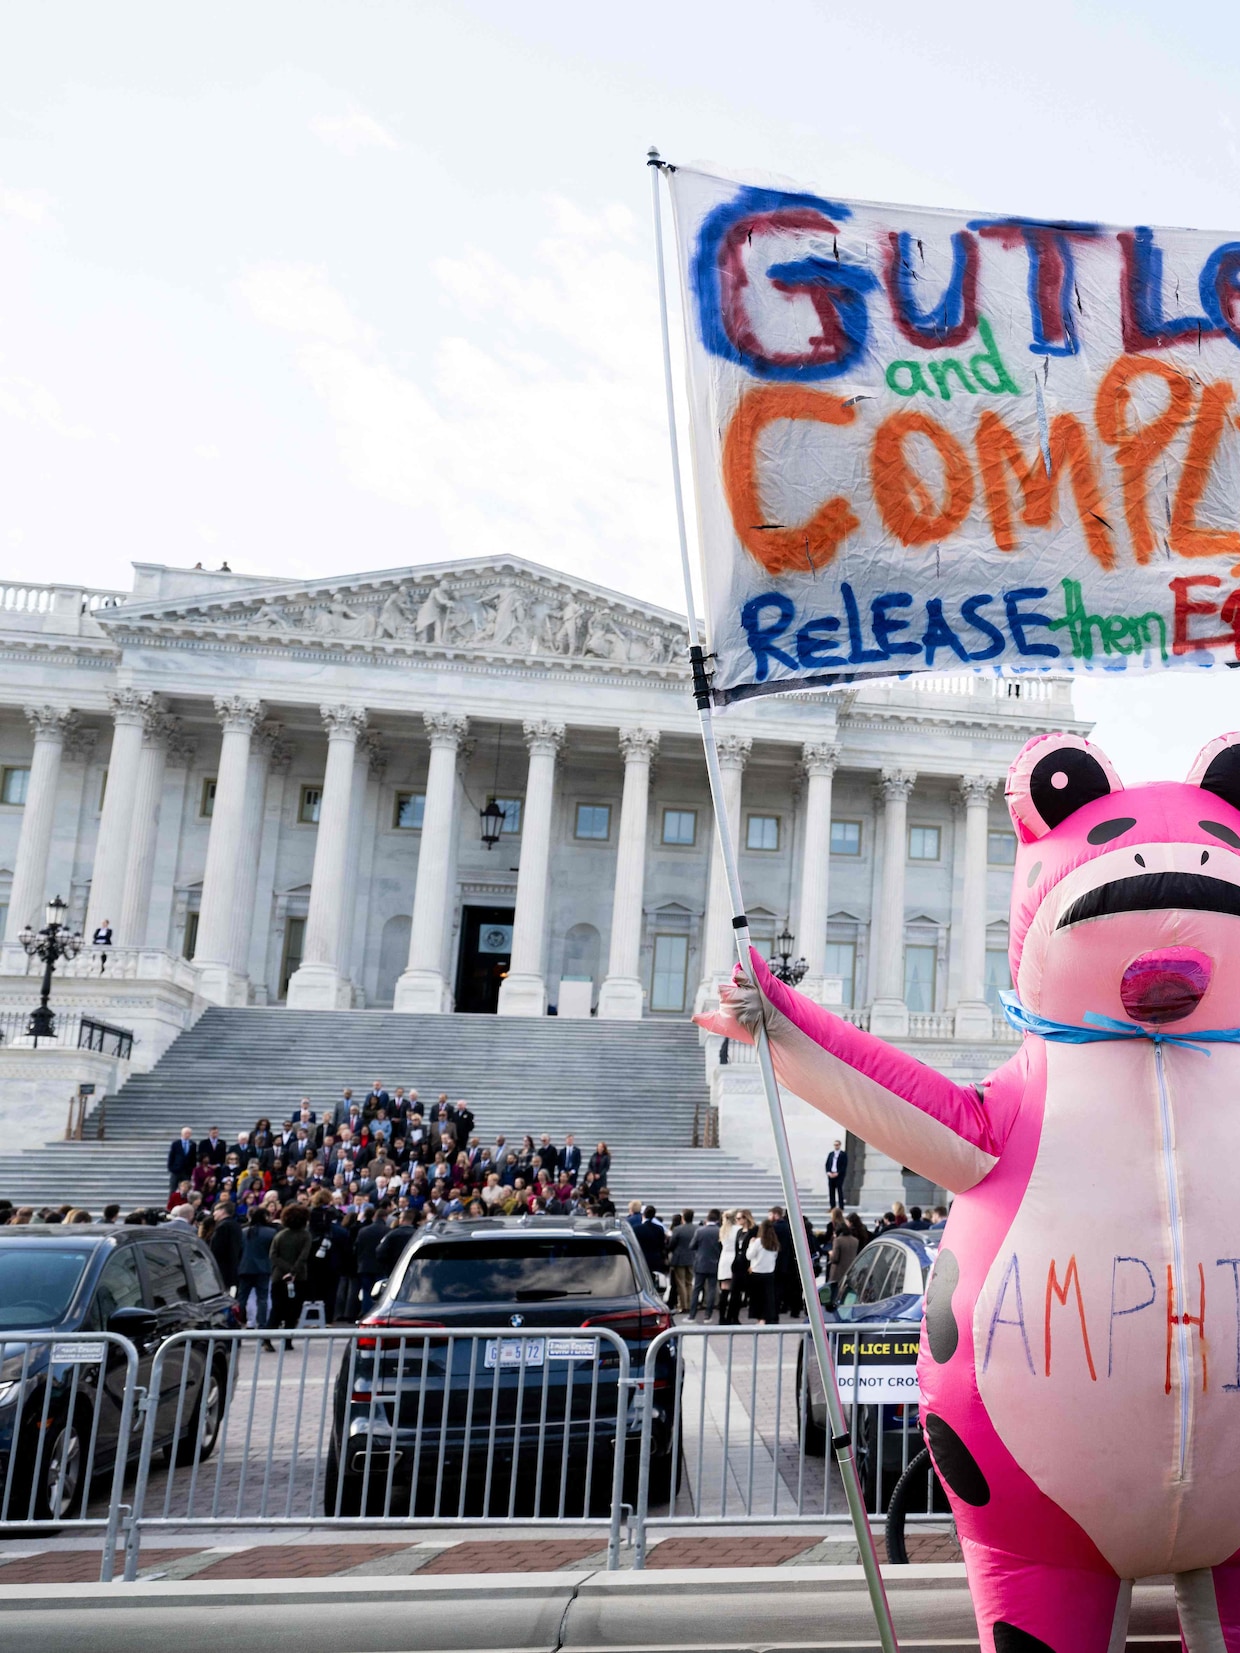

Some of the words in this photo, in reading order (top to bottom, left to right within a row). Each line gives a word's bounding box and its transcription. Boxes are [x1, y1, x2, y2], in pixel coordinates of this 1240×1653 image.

[886, 314, 1022, 401] and
[842, 1343, 891, 1355] POLICE
[894, 1343, 919, 1355] LIN
[859, 1378, 884, 1387] NOT
